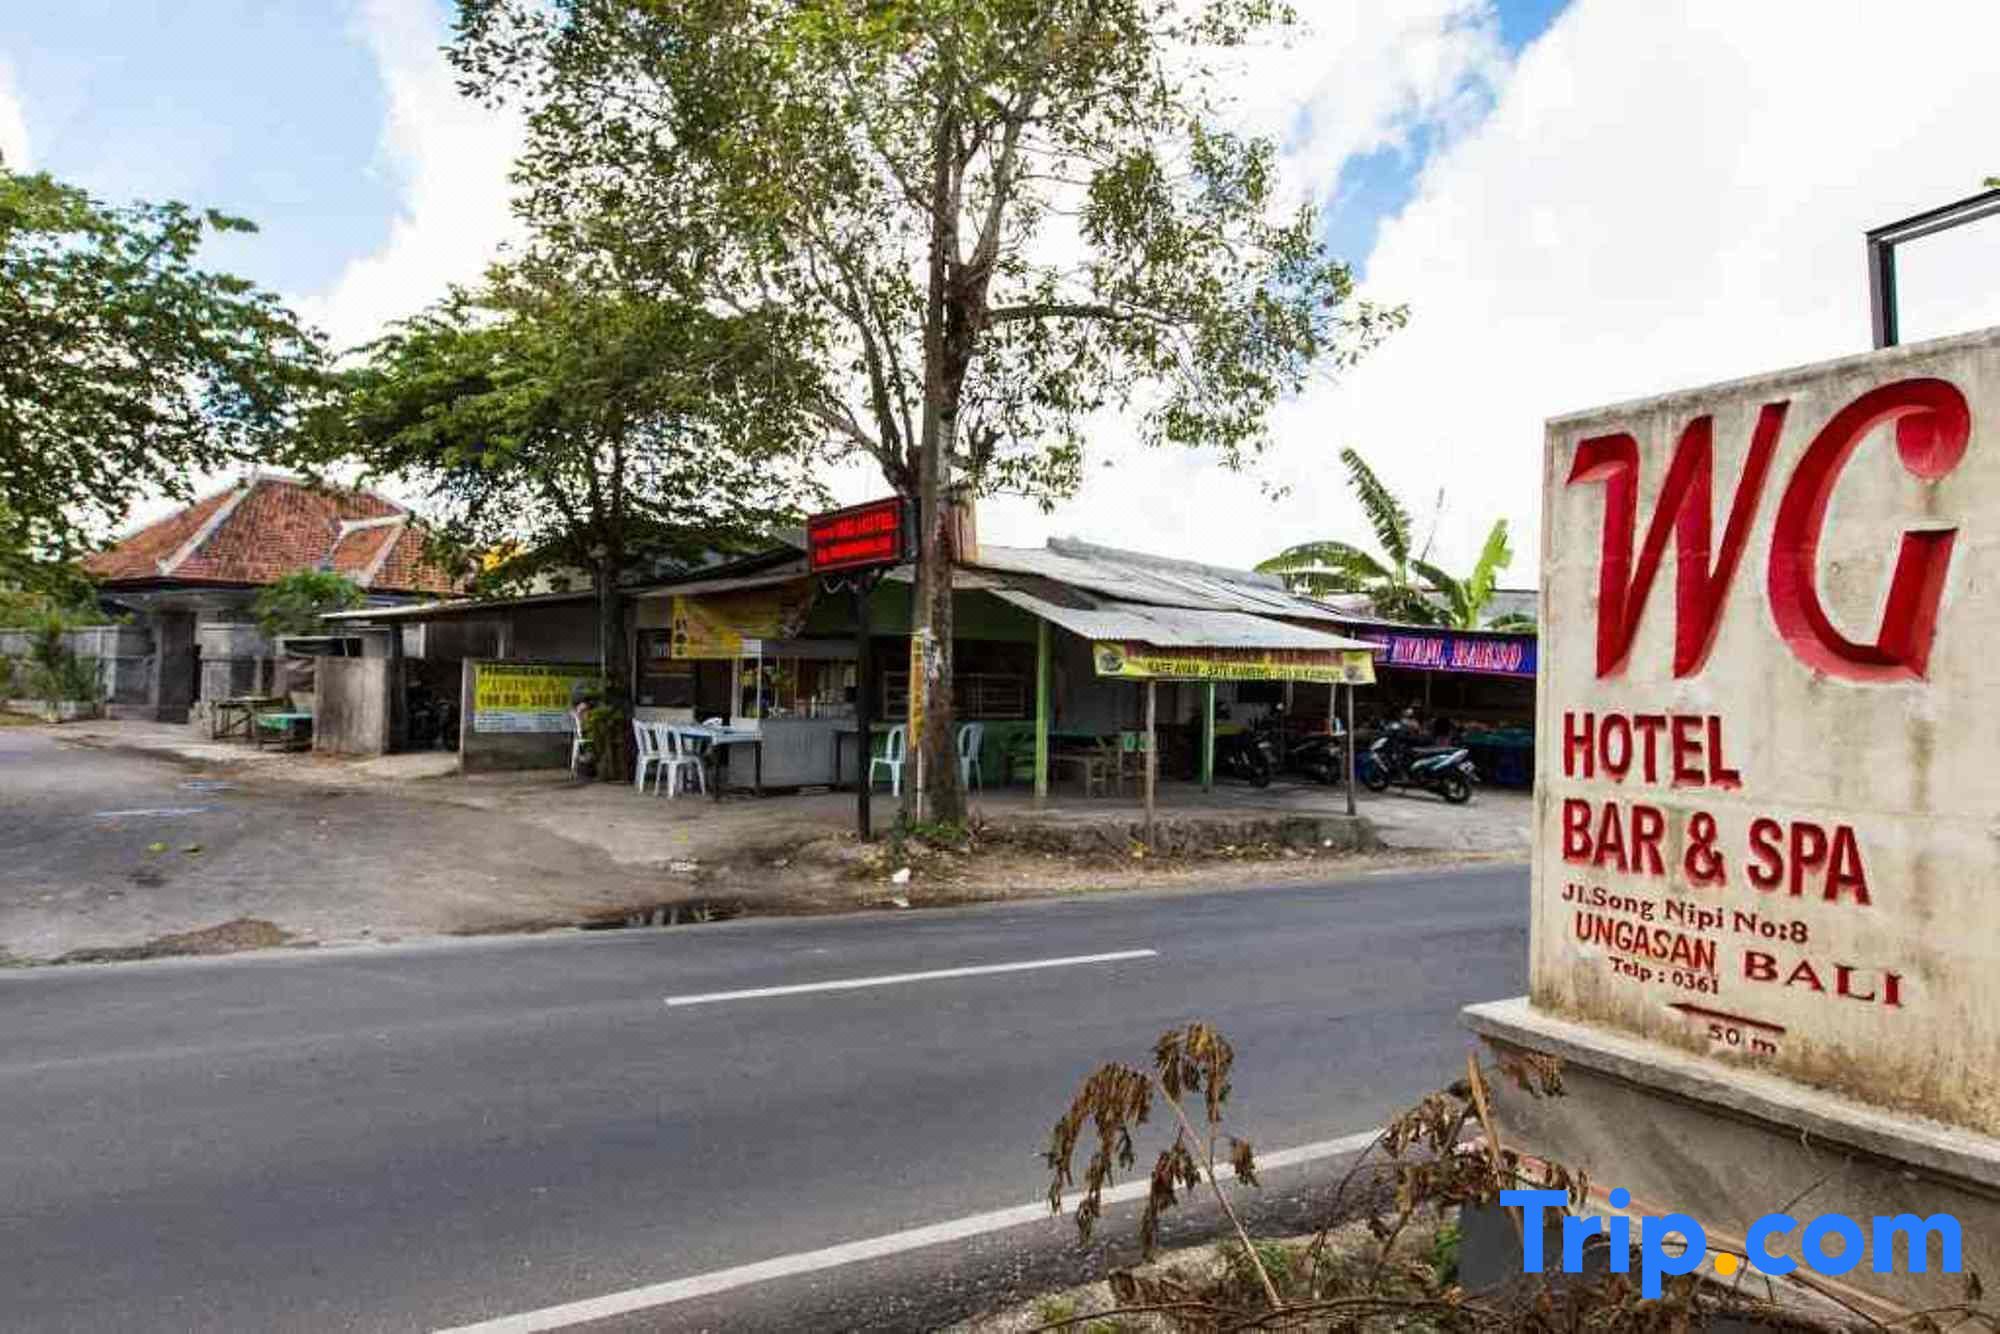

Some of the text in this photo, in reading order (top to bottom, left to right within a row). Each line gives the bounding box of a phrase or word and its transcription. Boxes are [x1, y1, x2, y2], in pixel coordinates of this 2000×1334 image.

[1565, 378, 1971, 682] WG
[1563, 712, 1742, 788] HOTEL
[1562, 798, 1872, 906] BAR & SPA
[1575, 911, 1904, 1008] UNGASAN BALI
[1665, 899, 1724, 931] Nipi
[1733, 911, 1809, 944] No:8
[1672, 971, 1719, 995] 0361
[1709, 1023, 1778, 1056] 50 m
